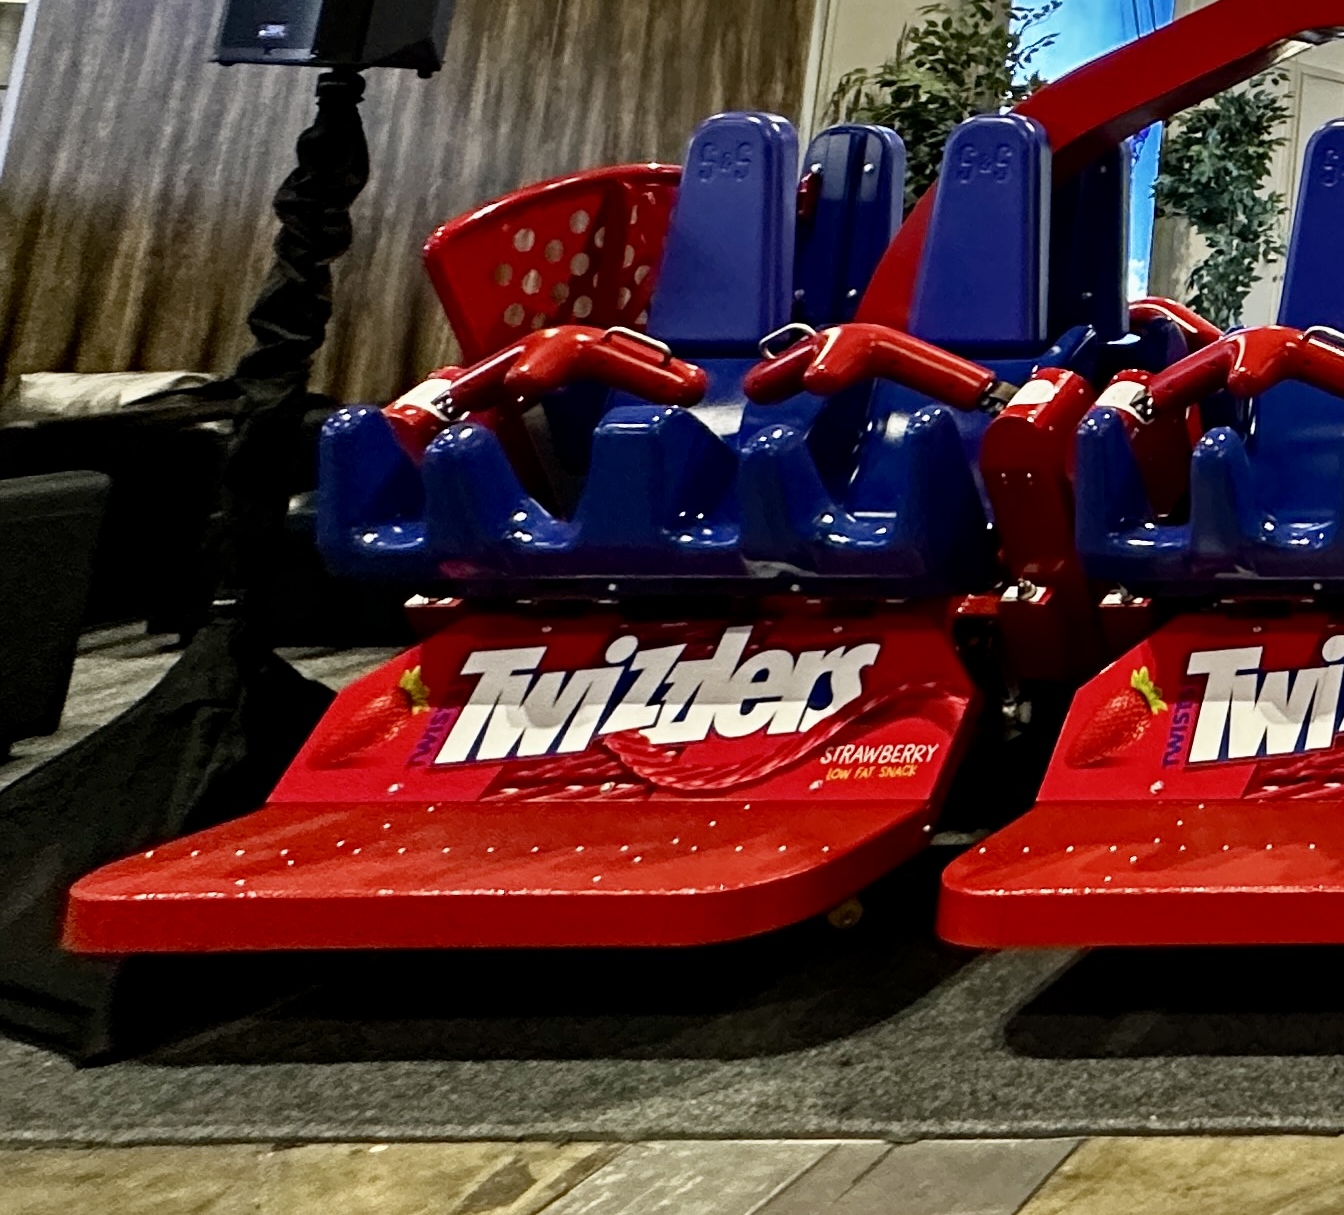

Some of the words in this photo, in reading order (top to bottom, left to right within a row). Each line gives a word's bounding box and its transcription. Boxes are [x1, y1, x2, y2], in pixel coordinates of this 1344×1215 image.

[820, 743, 939, 765] STRAWBERRY
[826, 766, 849, 780] LOW
[854, 766, 876, 778] FAT
[879, 764, 918, 778] SNACK
